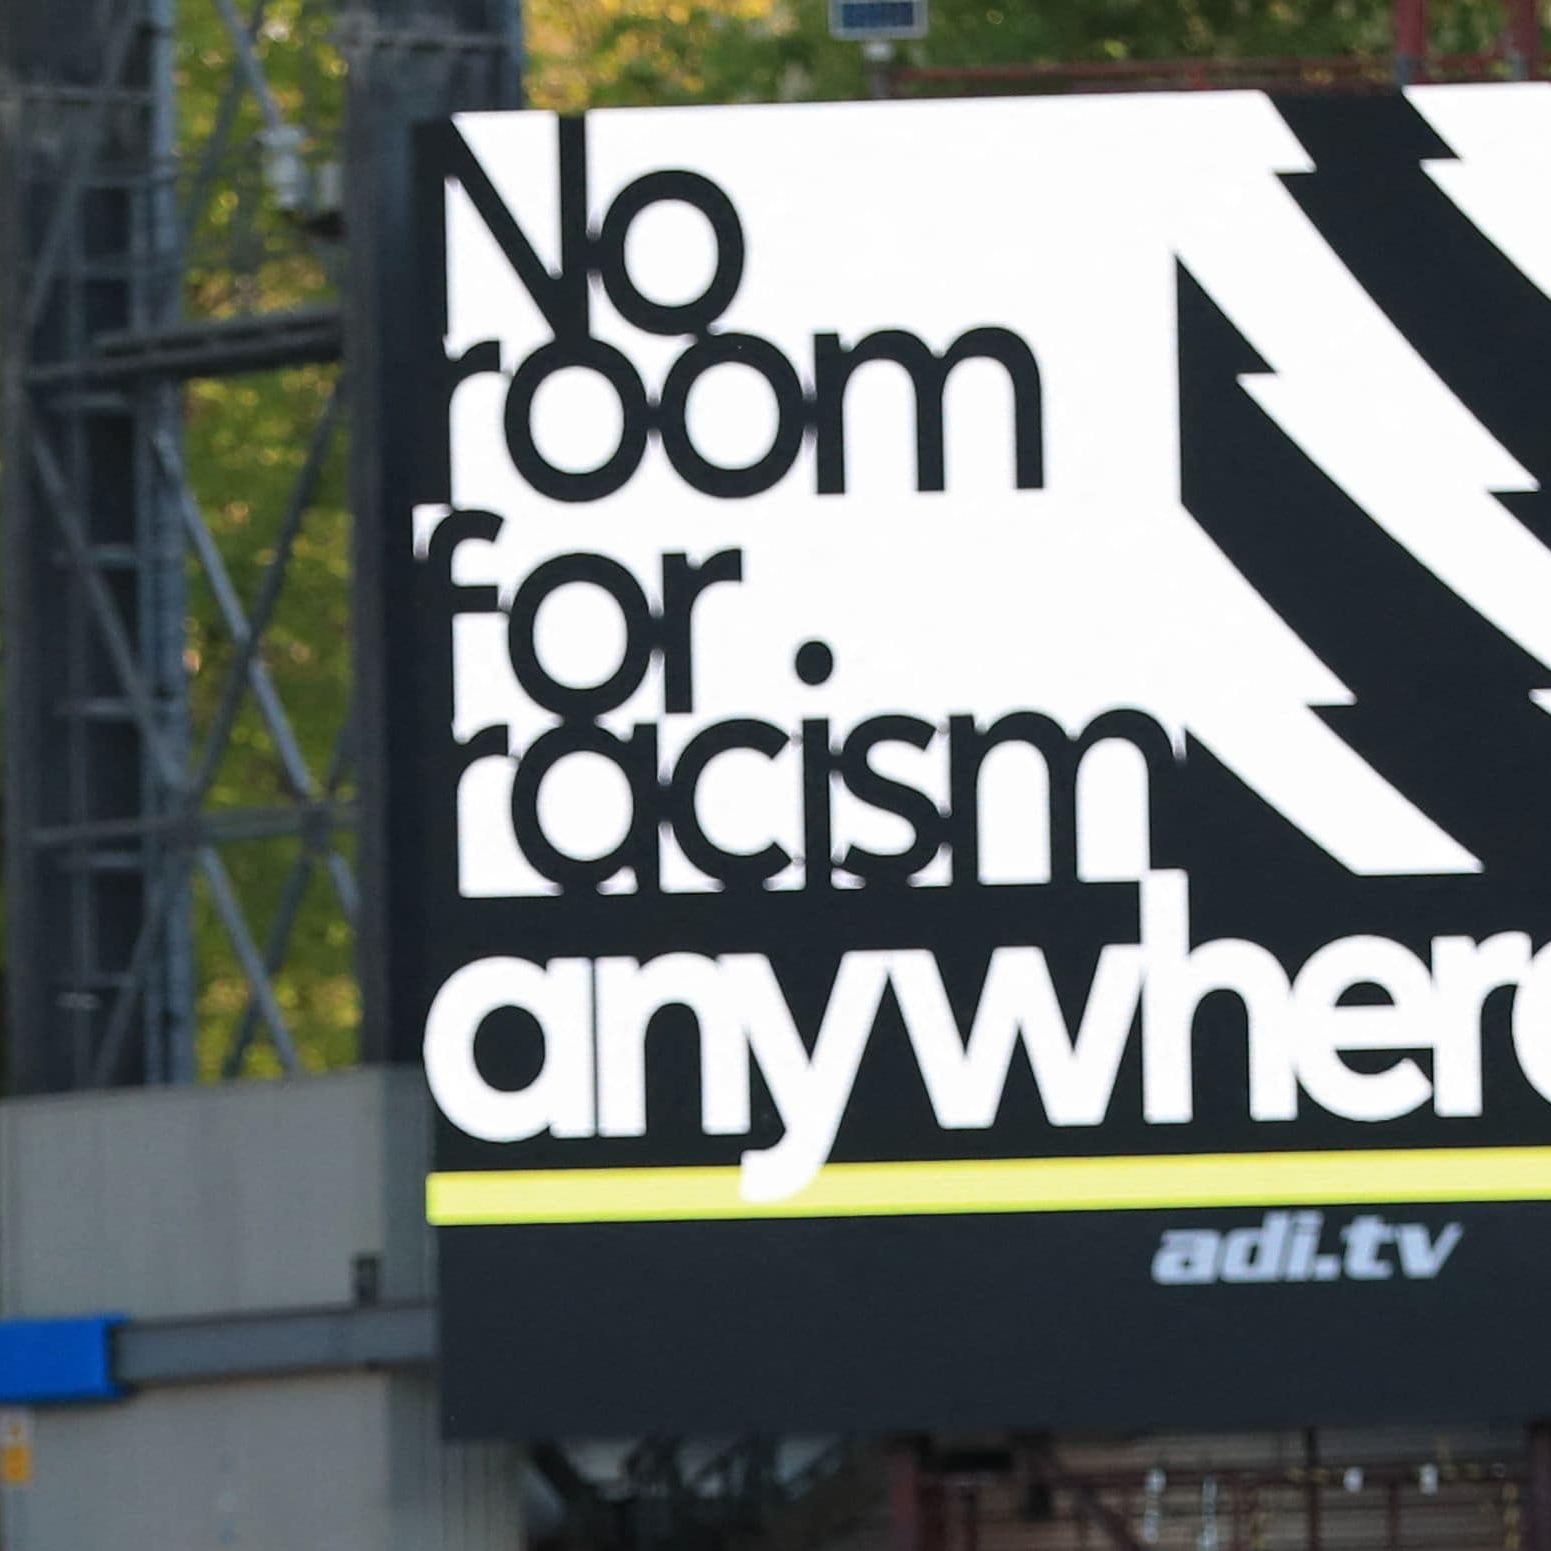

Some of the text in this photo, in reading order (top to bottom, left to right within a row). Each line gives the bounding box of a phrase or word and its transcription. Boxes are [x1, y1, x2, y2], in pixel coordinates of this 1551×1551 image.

[421, 112, 744, 337] No
[421, 325, 1046, 503] room
[421, 510, 743, 714] for
[425, 640, 1175, 896] racism
[1150, 1208, 1465, 1286] adi.tv
